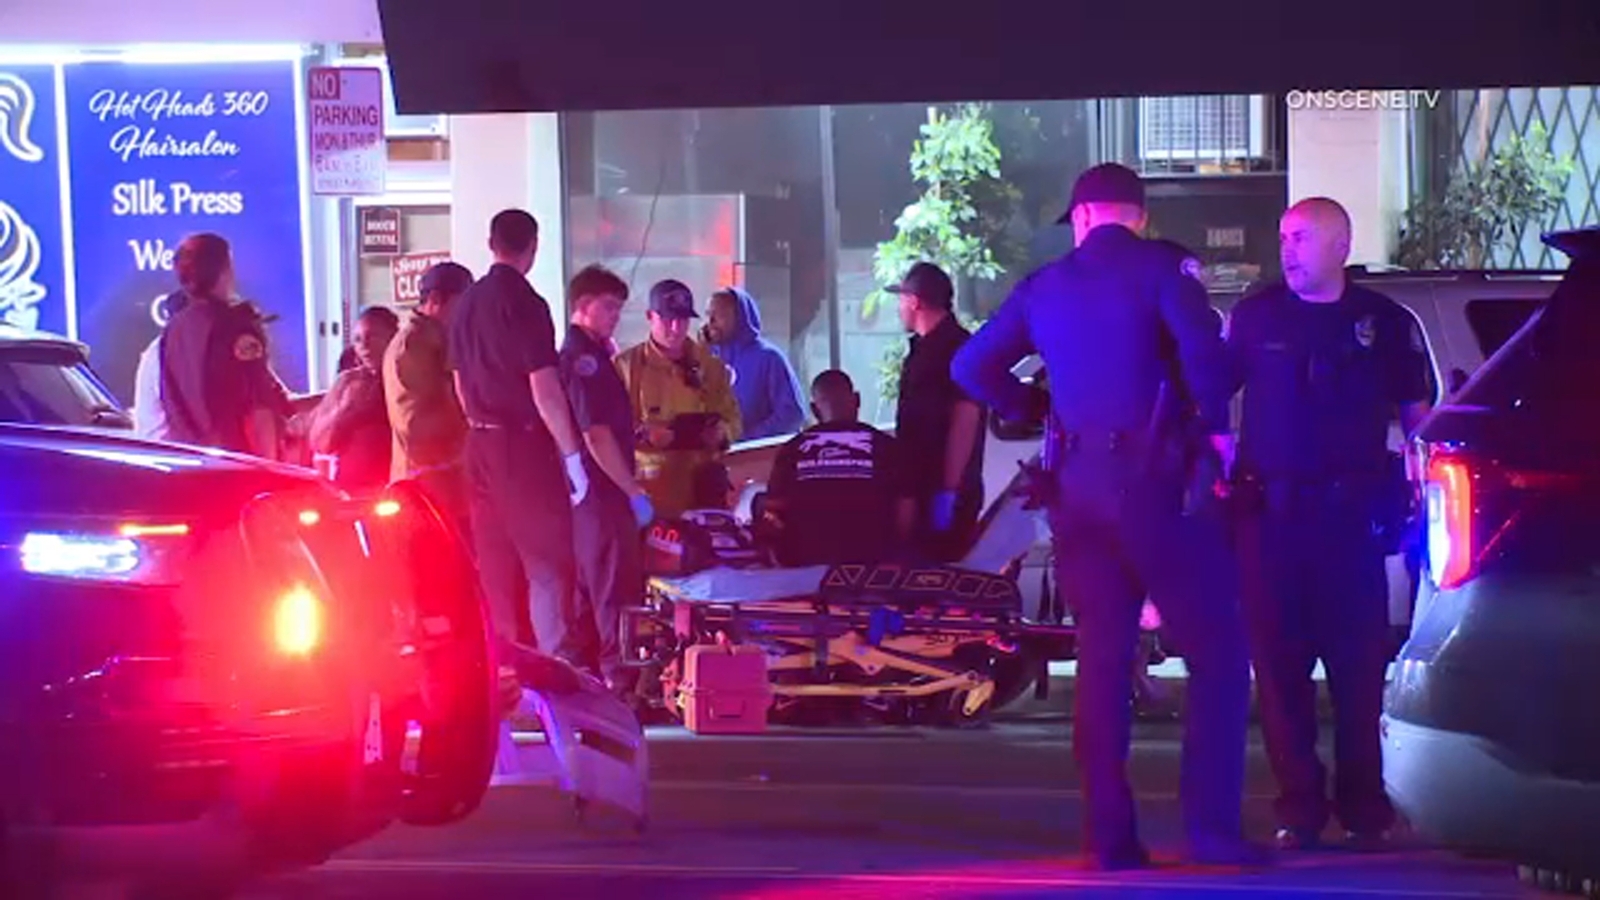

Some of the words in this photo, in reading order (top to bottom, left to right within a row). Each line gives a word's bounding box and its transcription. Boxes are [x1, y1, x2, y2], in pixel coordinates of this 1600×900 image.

[311, 72, 336, 98] NO
[89, 90, 138, 121] Hot
[142, 90, 216, 121] Heads
[222, 91, 269, 116] 360
[314, 104, 378, 126] PARKING
[110, 126, 240, 161] Hairsalon
[169, 183, 244, 215] Press
